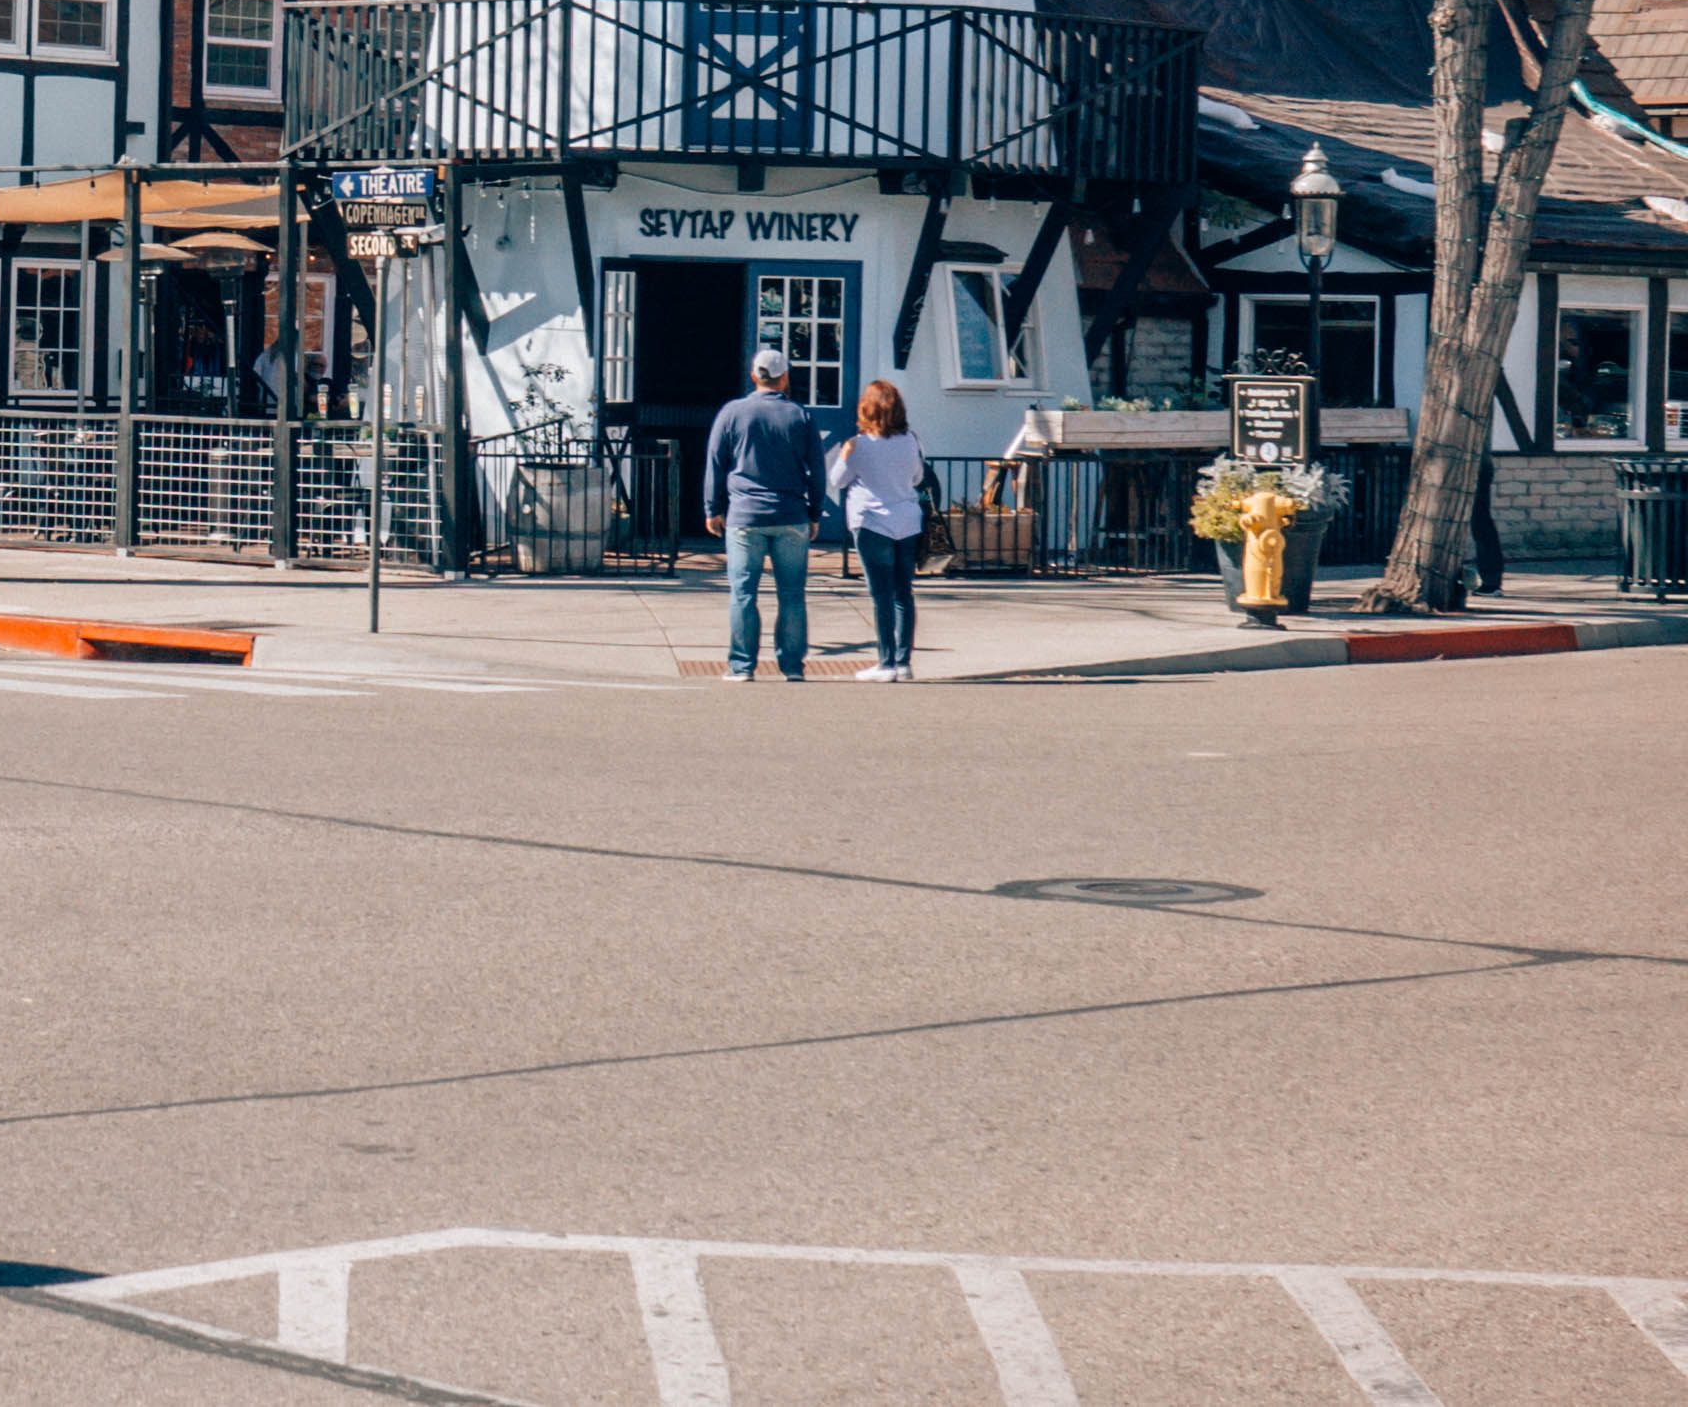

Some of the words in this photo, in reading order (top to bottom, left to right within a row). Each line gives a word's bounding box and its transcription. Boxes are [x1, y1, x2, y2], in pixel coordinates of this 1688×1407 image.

[359, 173, 426, 195] THEATRE
[346, 204, 415, 225] COPENHAGEN
[639, 207, 735, 239] SEVTAP
[746, 211, 859, 242] WINERY
[350, 235, 396, 256] SECOND
